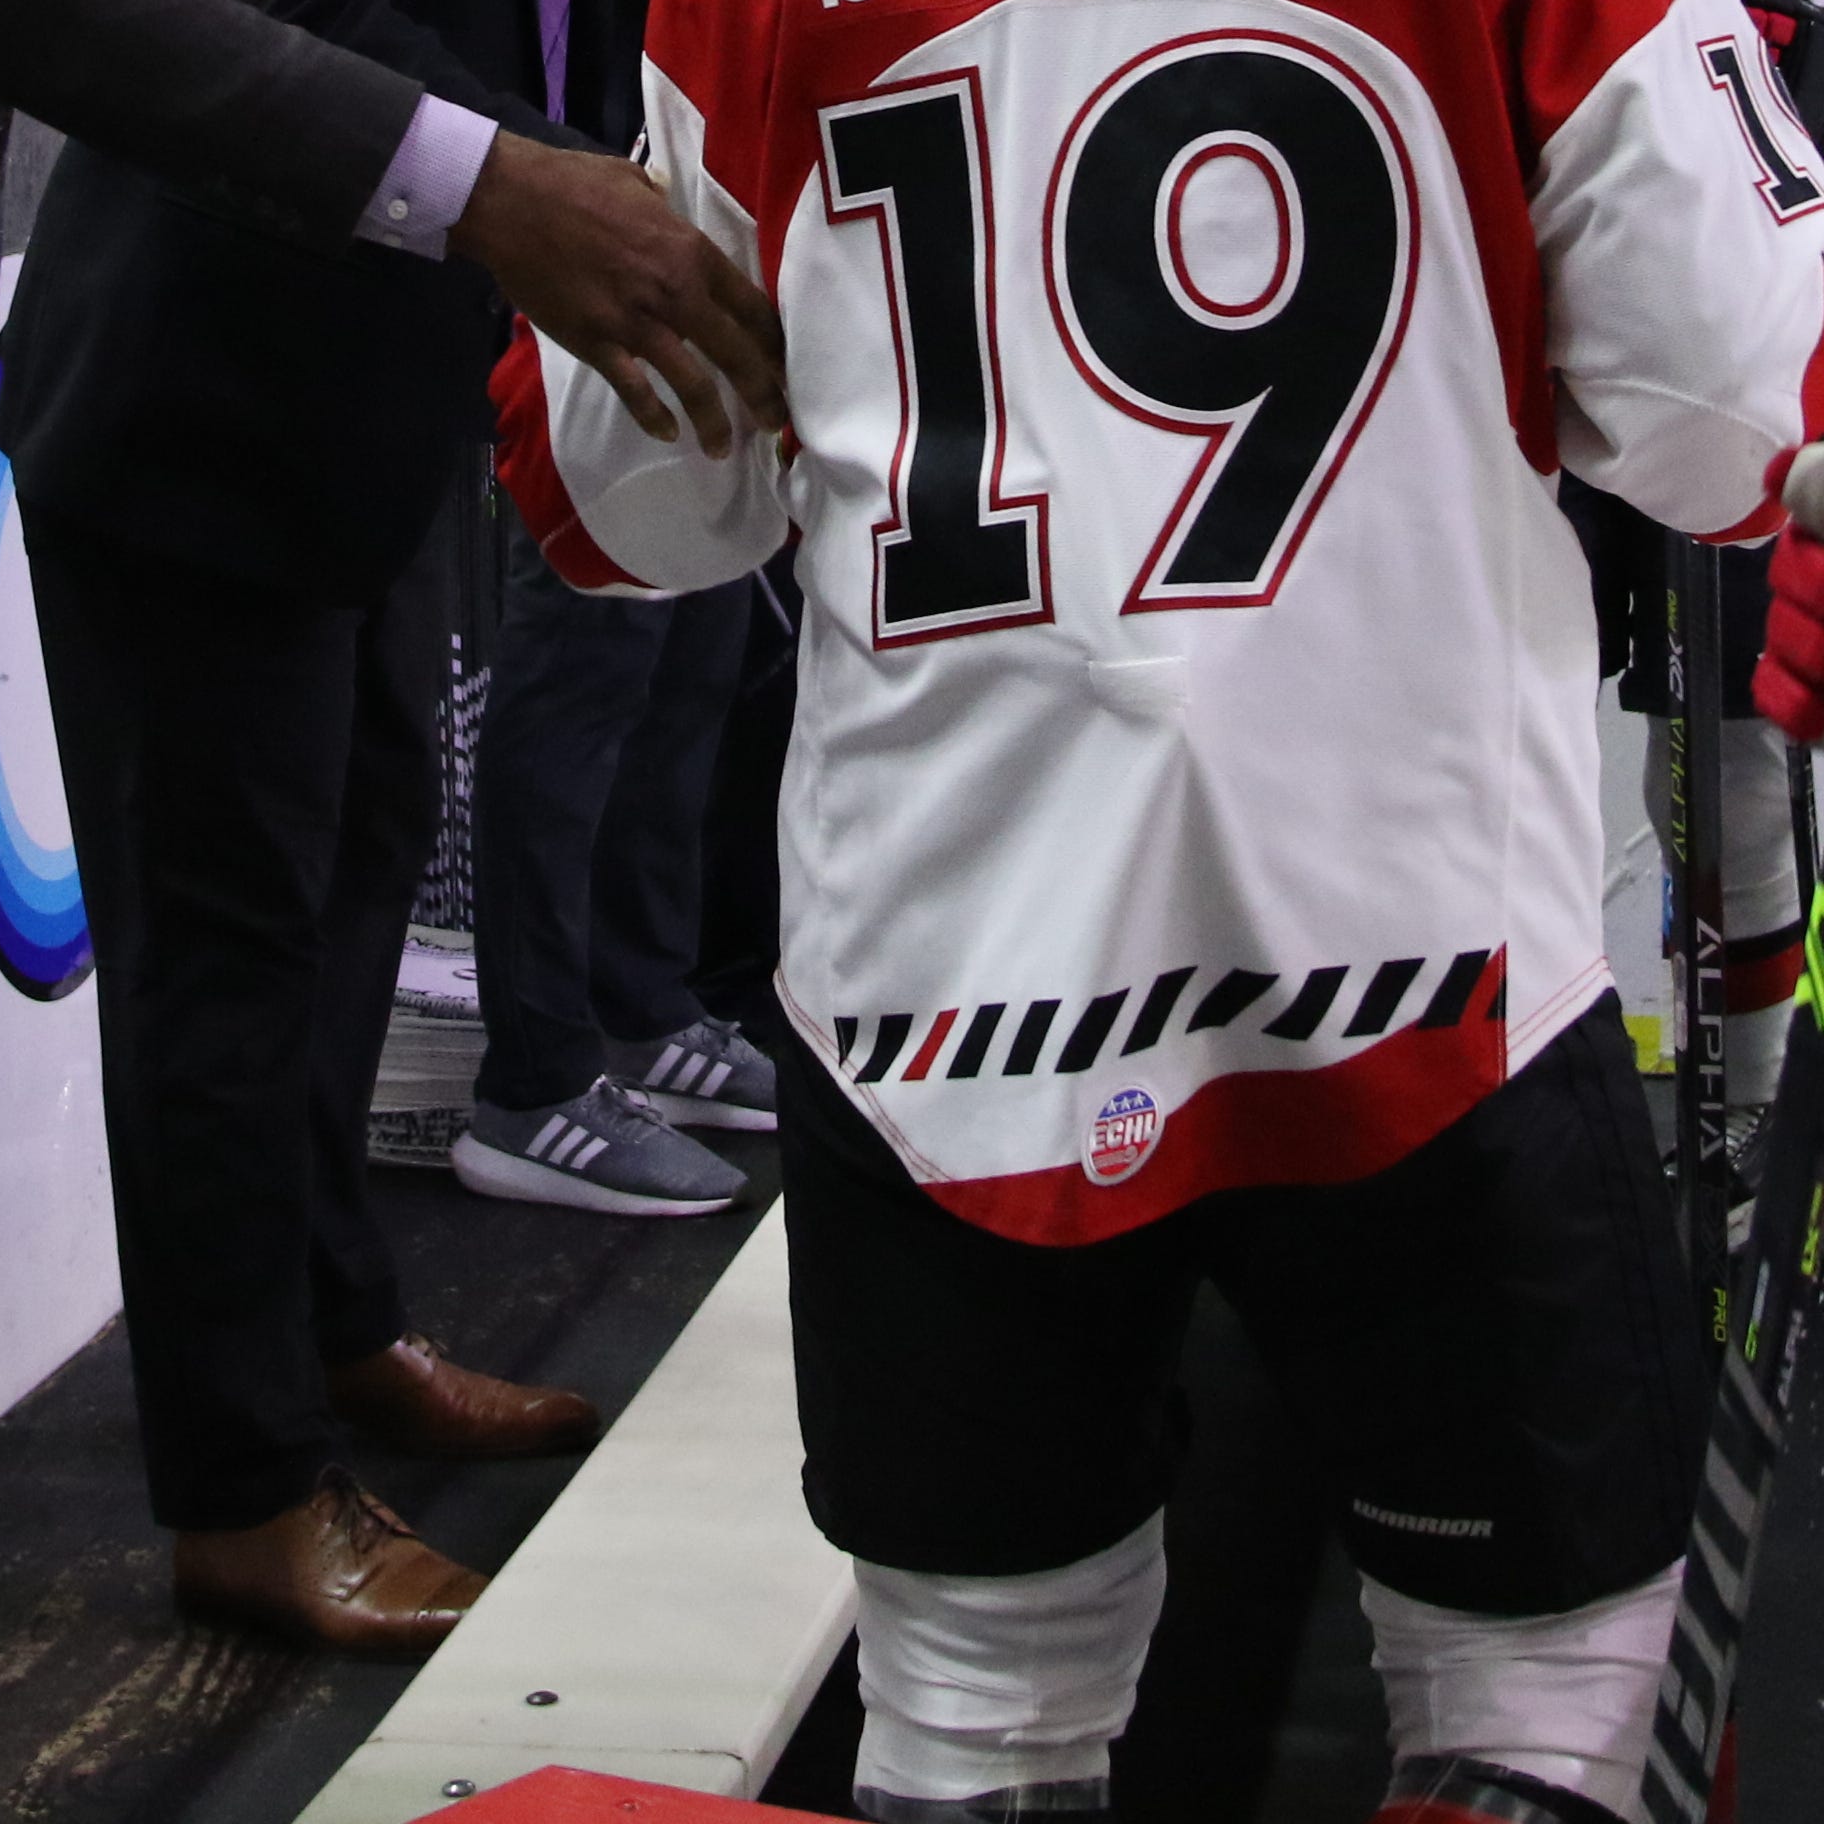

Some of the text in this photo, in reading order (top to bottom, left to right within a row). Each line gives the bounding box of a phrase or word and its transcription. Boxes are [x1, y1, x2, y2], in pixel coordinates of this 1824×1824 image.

[818, 28, 1421, 650] 19
[1088, 1112, 1157, 1152] ECHL
[1696, 916, 1724, 1162] ALPHA
[1712, 1286, 1728, 1344] PRO
[1352, 1496, 1493, 1539] WARRIOR
